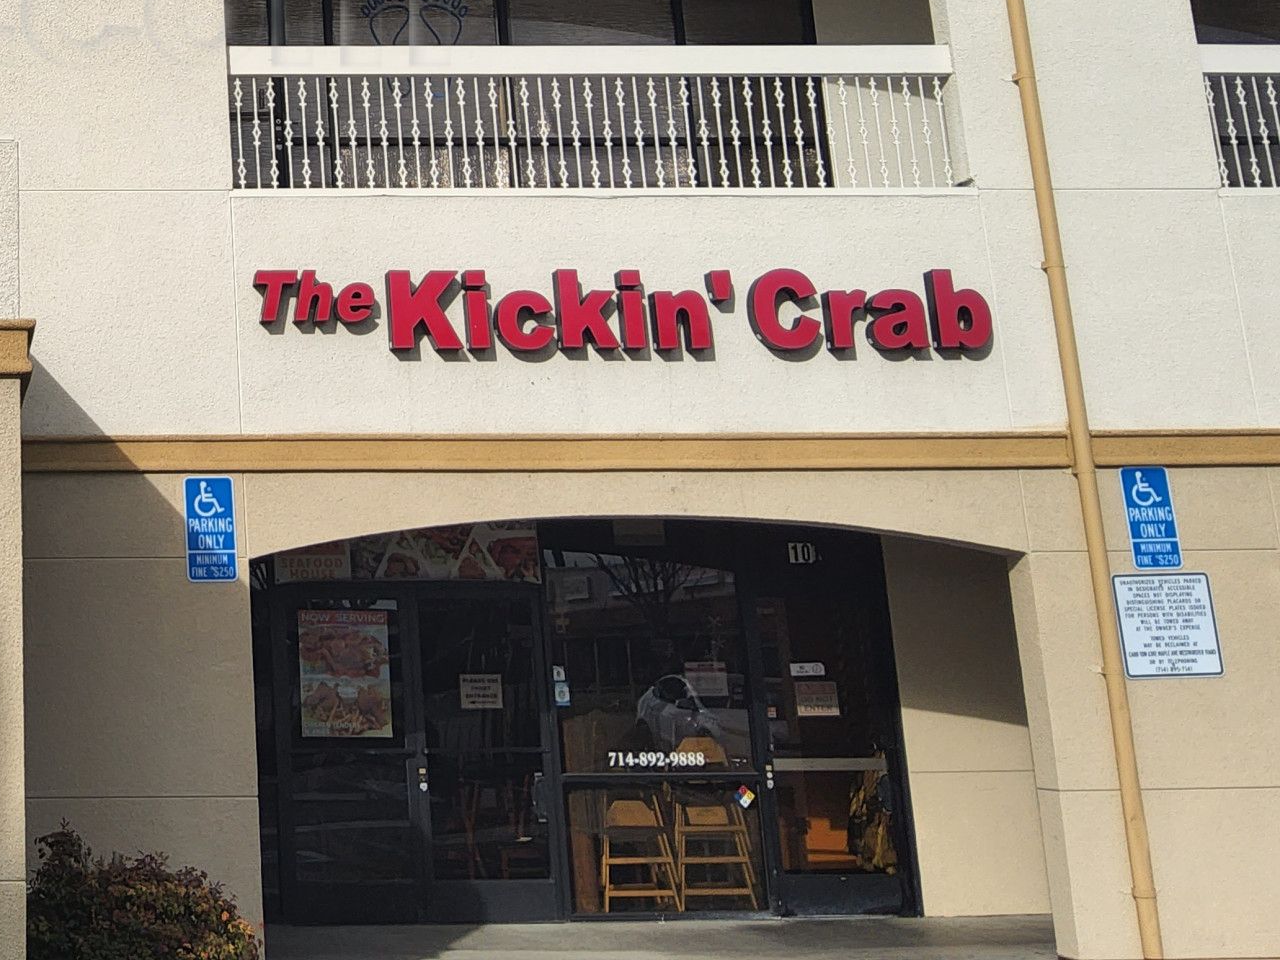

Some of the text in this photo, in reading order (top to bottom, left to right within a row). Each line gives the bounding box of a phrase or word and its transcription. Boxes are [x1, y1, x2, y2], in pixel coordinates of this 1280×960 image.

[253, 268, 995, 355] The Kickin' Crab
[1129, 506, 1173, 522] PARKING
[188, 516, 233, 532] PARKING
[1140, 523, 1166, 538] ONLY
[198, 534, 225, 549] ONLY
[1140, 543, 1173, 553] MINIMUM
[196, 554, 229, 565] MINIMUM
[280, 557, 344, 569] SEAFOOD
[1137, 554, 1154, 565] FINE
[191, 567, 208, 578] FINE
[289, 569, 336, 580] HOUSE
[301, 612, 384, 623] NOW SERVING
[608, 751, 706, 767] 714-892-9888
